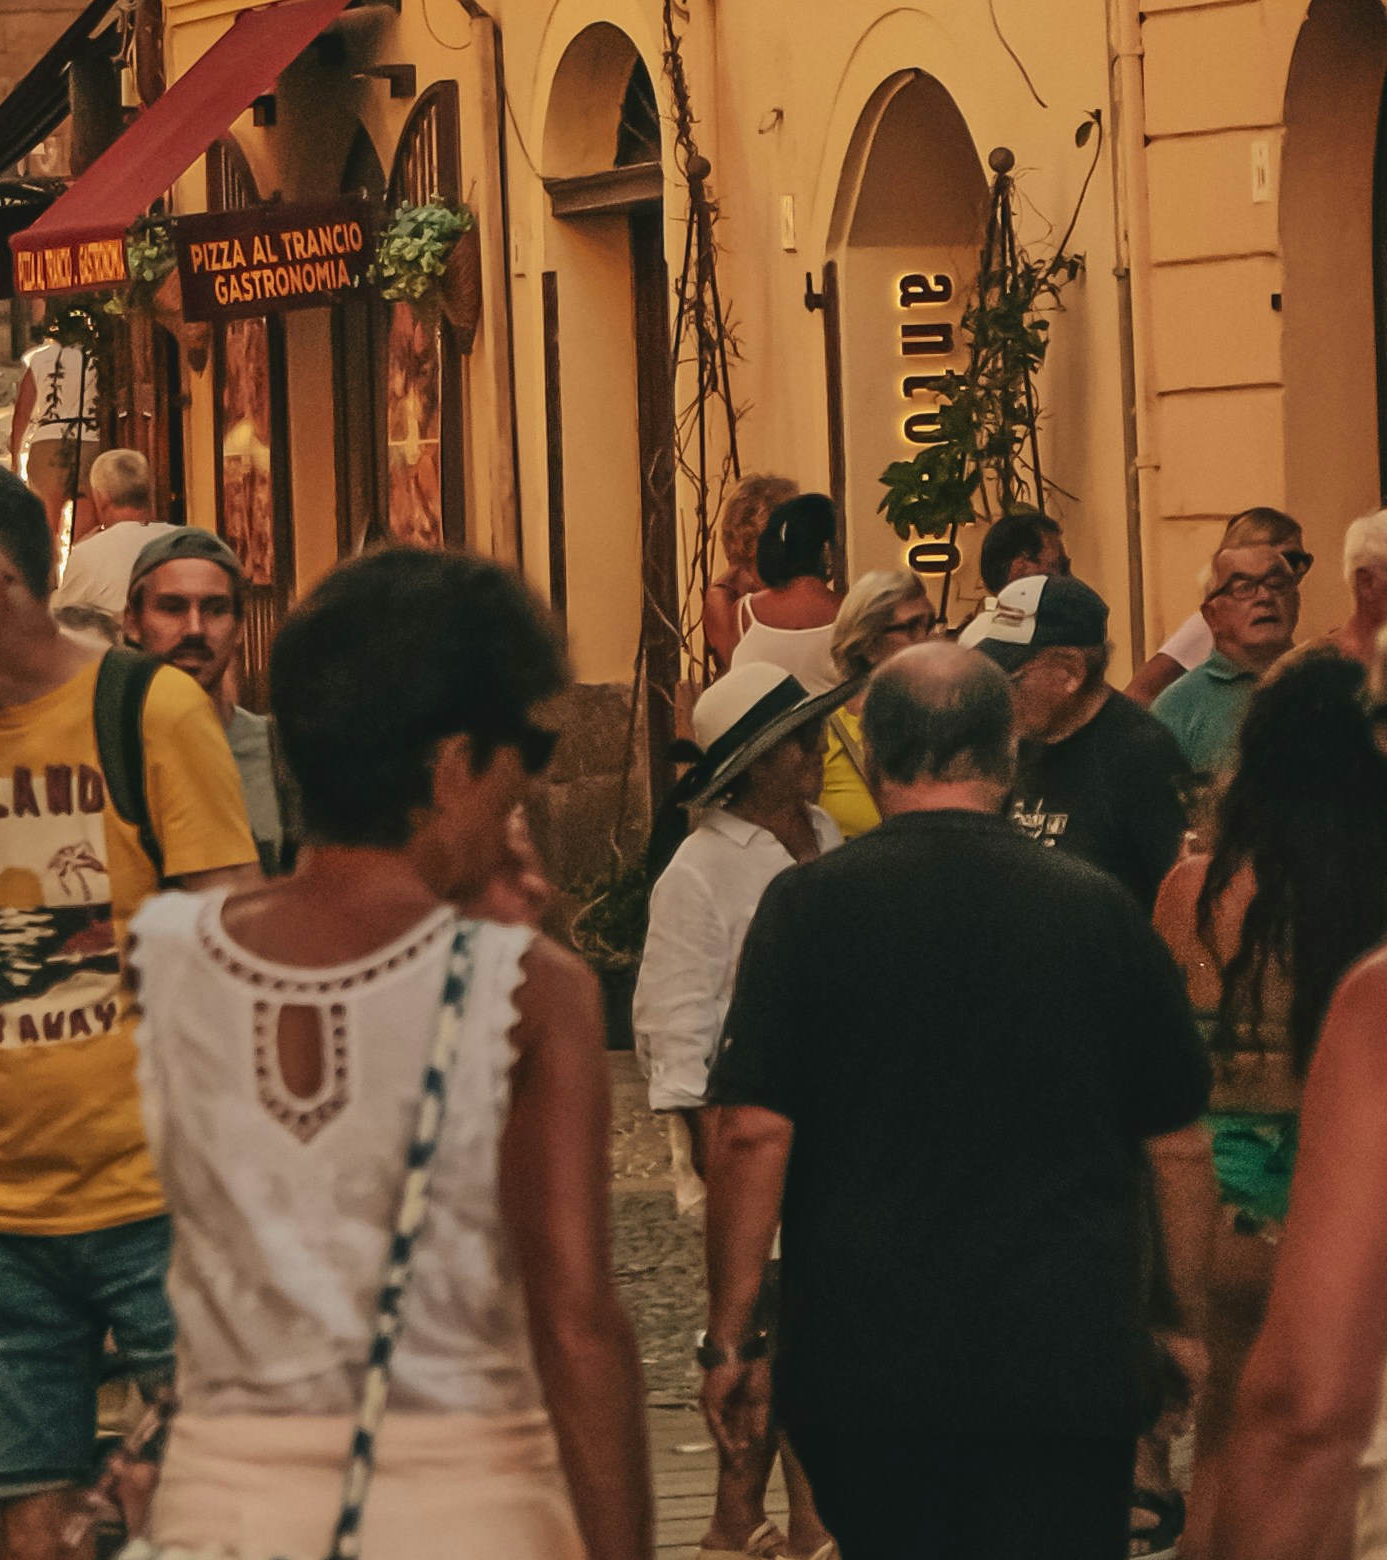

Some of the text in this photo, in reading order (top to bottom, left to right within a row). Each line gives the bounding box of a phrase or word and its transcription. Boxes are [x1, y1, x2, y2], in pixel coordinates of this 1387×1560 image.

[189, 221, 364, 274] PIZZA AL TRANCIO
[213, 257, 352, 306] GASTRONOMIA
[18, 1000, 118, 1043] AWAY
